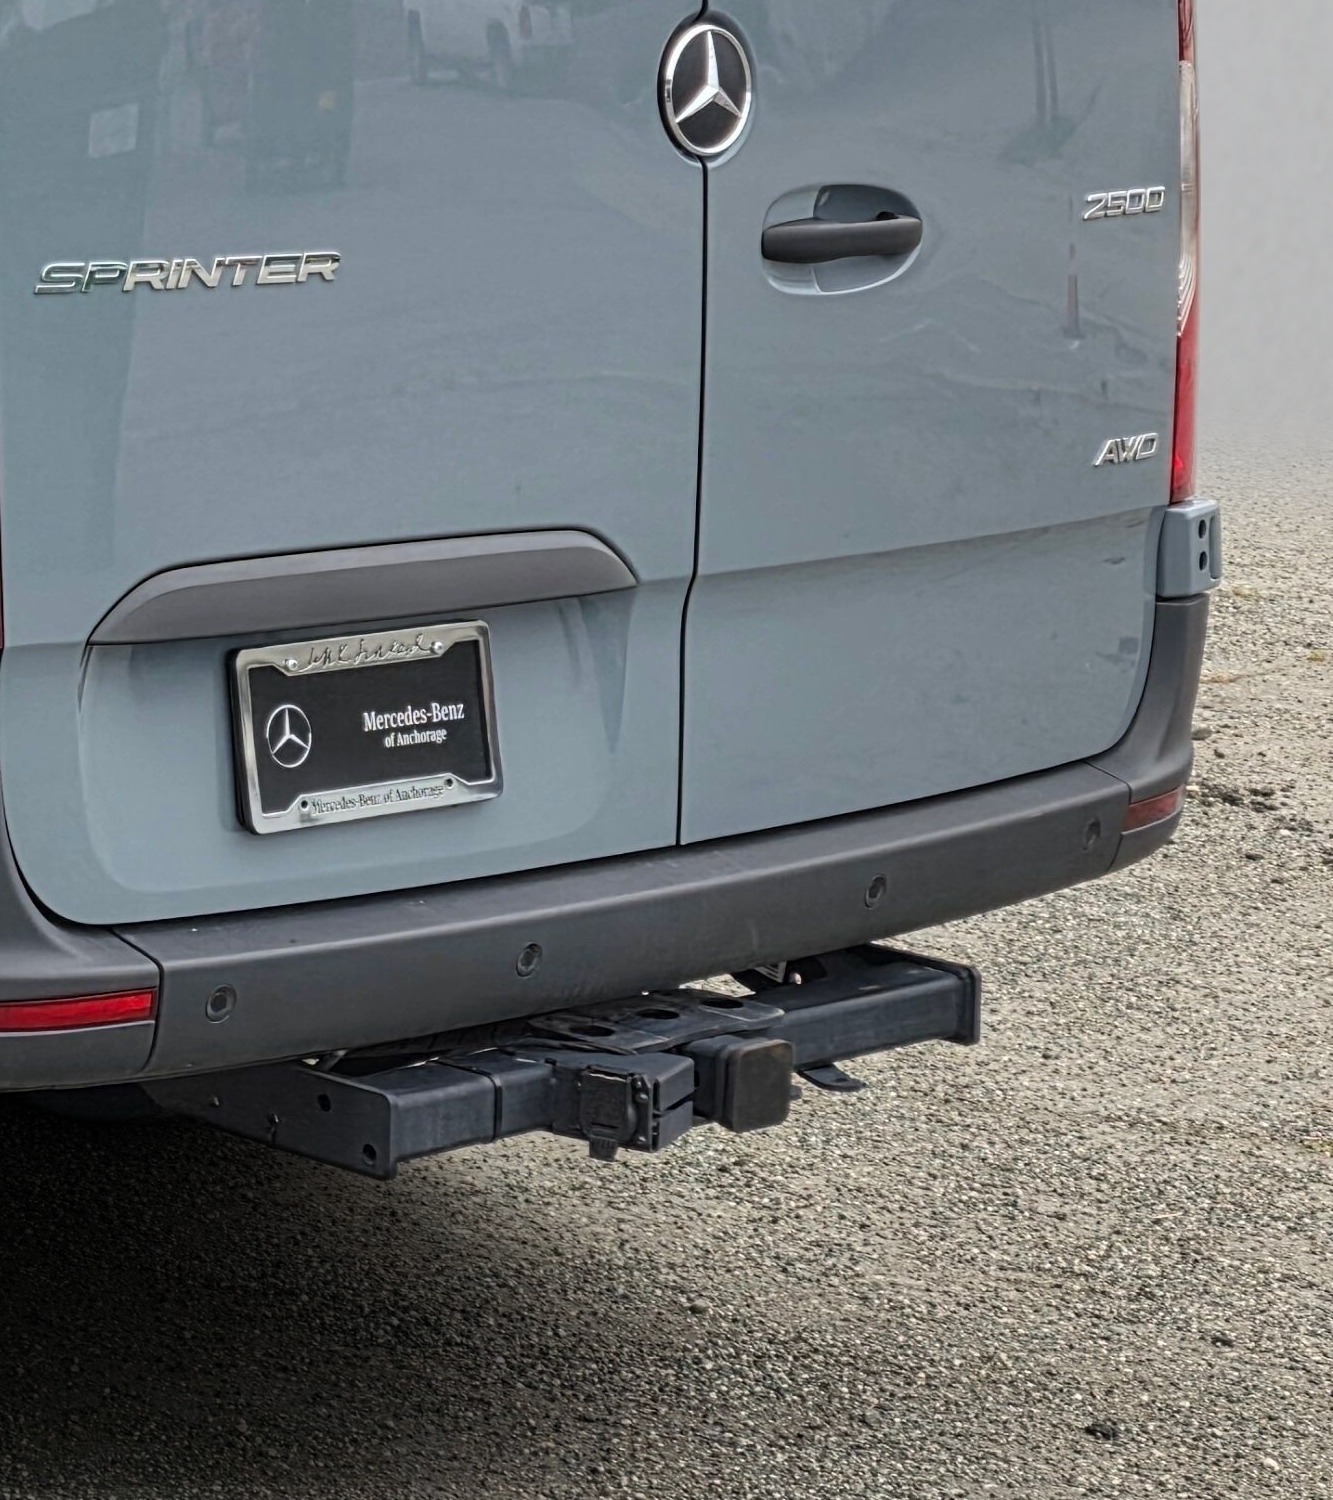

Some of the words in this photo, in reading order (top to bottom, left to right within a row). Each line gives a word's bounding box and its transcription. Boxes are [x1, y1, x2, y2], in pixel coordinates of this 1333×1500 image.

[1083, 186, 1165, 220] 2500
[34, 251, 341, 294] SPRINTER
[1093, 432, 1158, 467] AWD
[363, 702, 465, 732] Mercedes-Benz
[384, 732, 395, 748] of
[396, 729, 447, 747] Anchorage
[312, 793, 381, 814] Mercedes-Benz
[383, 788, 394, 803] of
[395, 785, 445, 801] Anchorage
